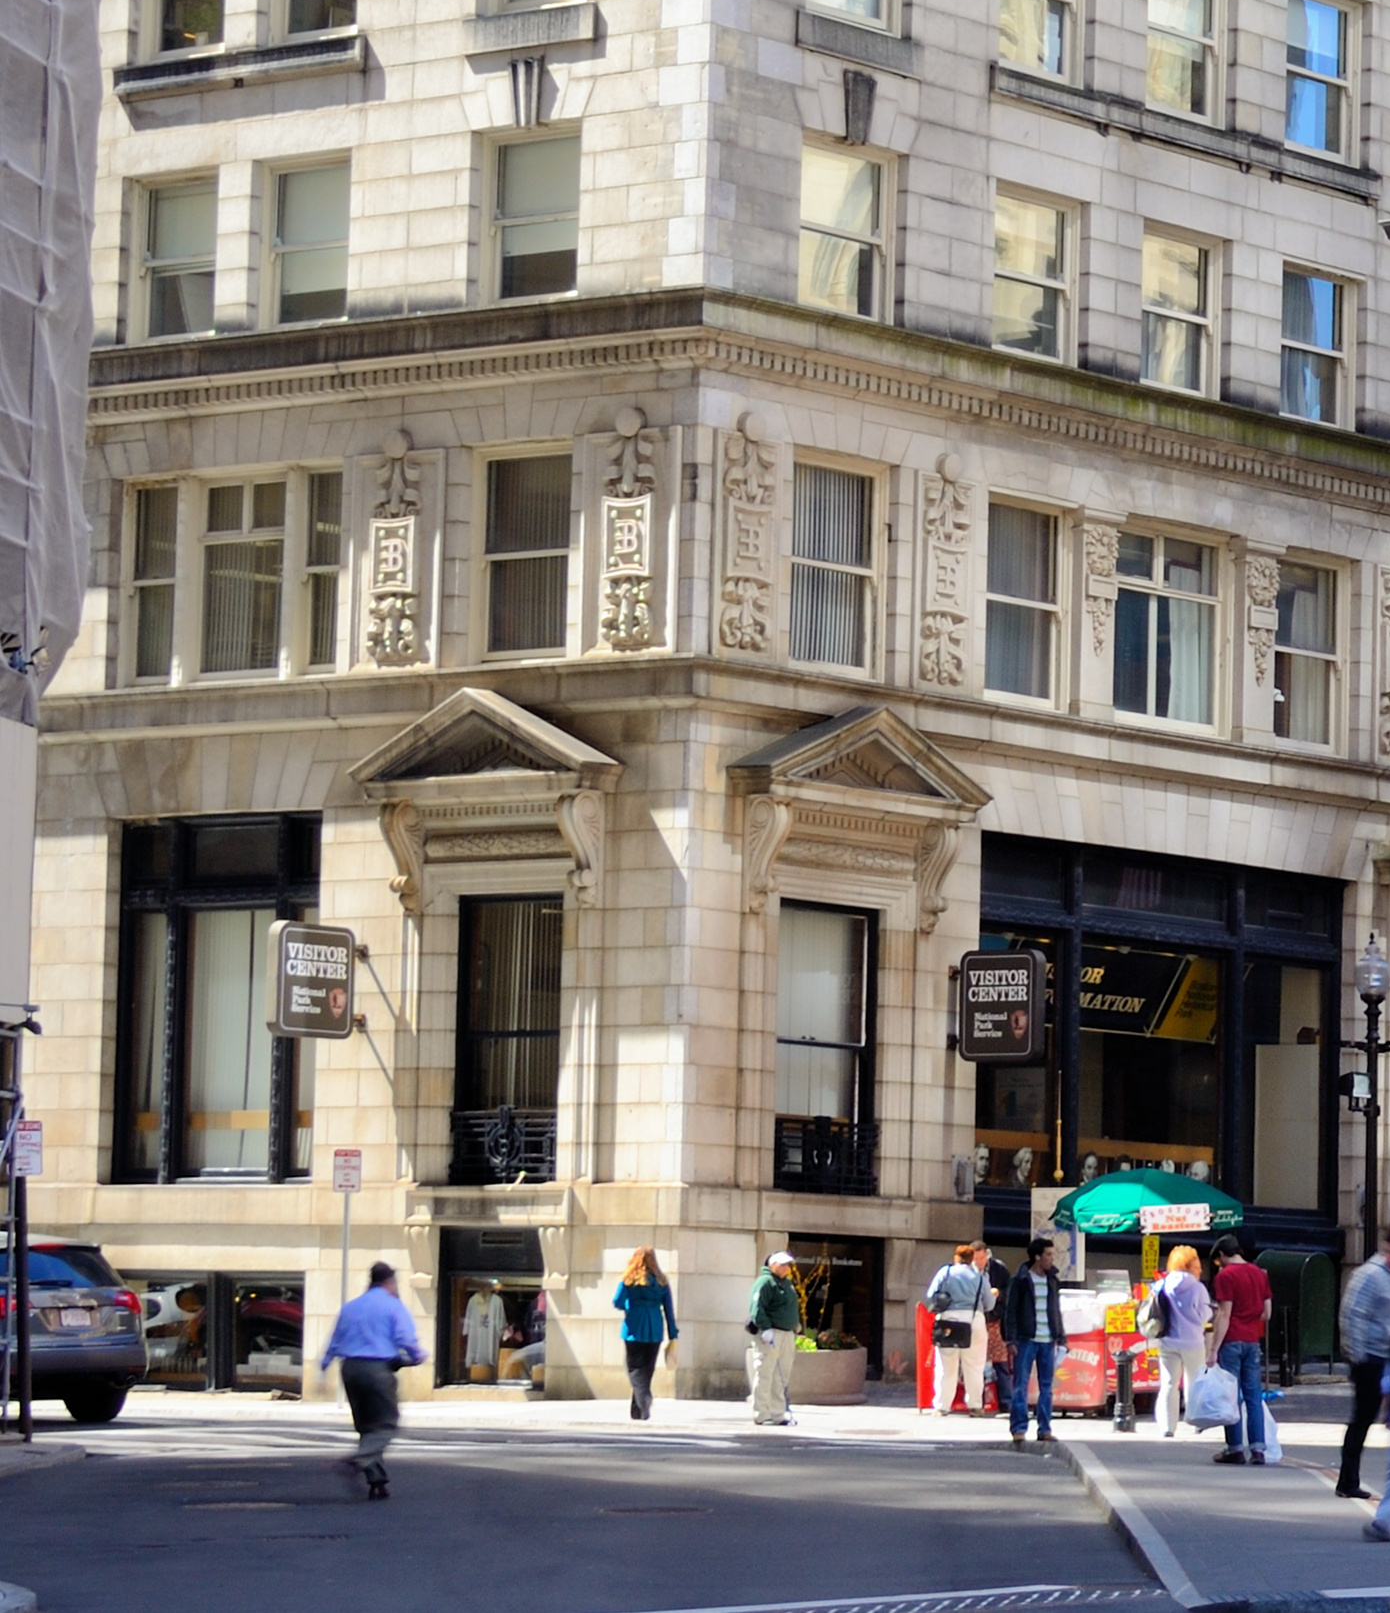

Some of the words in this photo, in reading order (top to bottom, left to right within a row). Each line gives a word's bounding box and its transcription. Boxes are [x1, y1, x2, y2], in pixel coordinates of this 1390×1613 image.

[286, 942, 348, 964] VISITOR
[286, 959, 348, 980] CENTER
[968, 969, 1029, 986] VISITOR
[292, 986, 326, 998] National
[968, 986, 1028, 1002] CENTER
[292, 996, 311, 1005] Park
[291, 1005, 321, 1014] Service
[974, 1012, 1008, 1021] National
[974, 1021, 993, 1029] Park
[973, 1030, 1003, 1038] Service
[1150, 1206, 1200, 1218] BOSTON
[1166, 1215, 1187, 1223] Nut
[1152, 1222, 1202, 1231] Roasters
